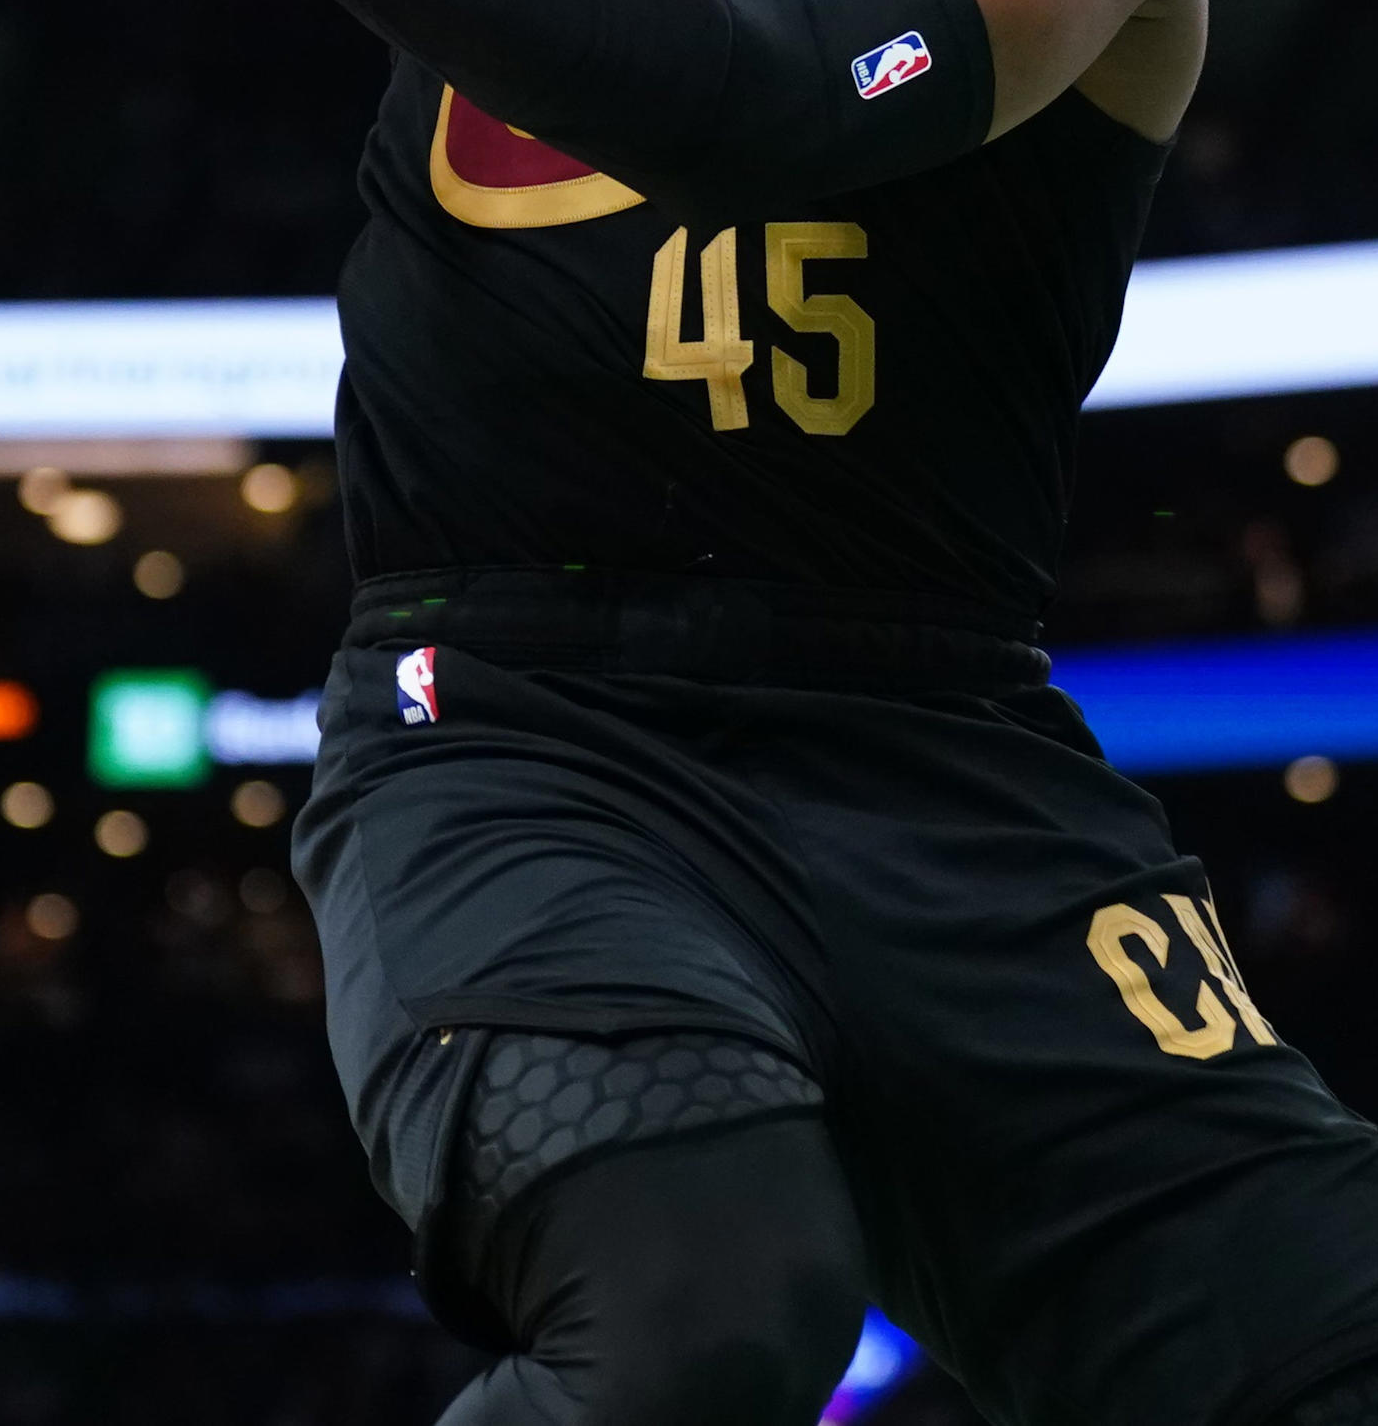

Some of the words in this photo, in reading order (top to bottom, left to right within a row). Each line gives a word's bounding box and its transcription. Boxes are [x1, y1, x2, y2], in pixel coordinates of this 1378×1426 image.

[855, 60, 873, 87] NBA
[643, 221, 876, 437] 45
[402, 704, 426, 725] NBA
